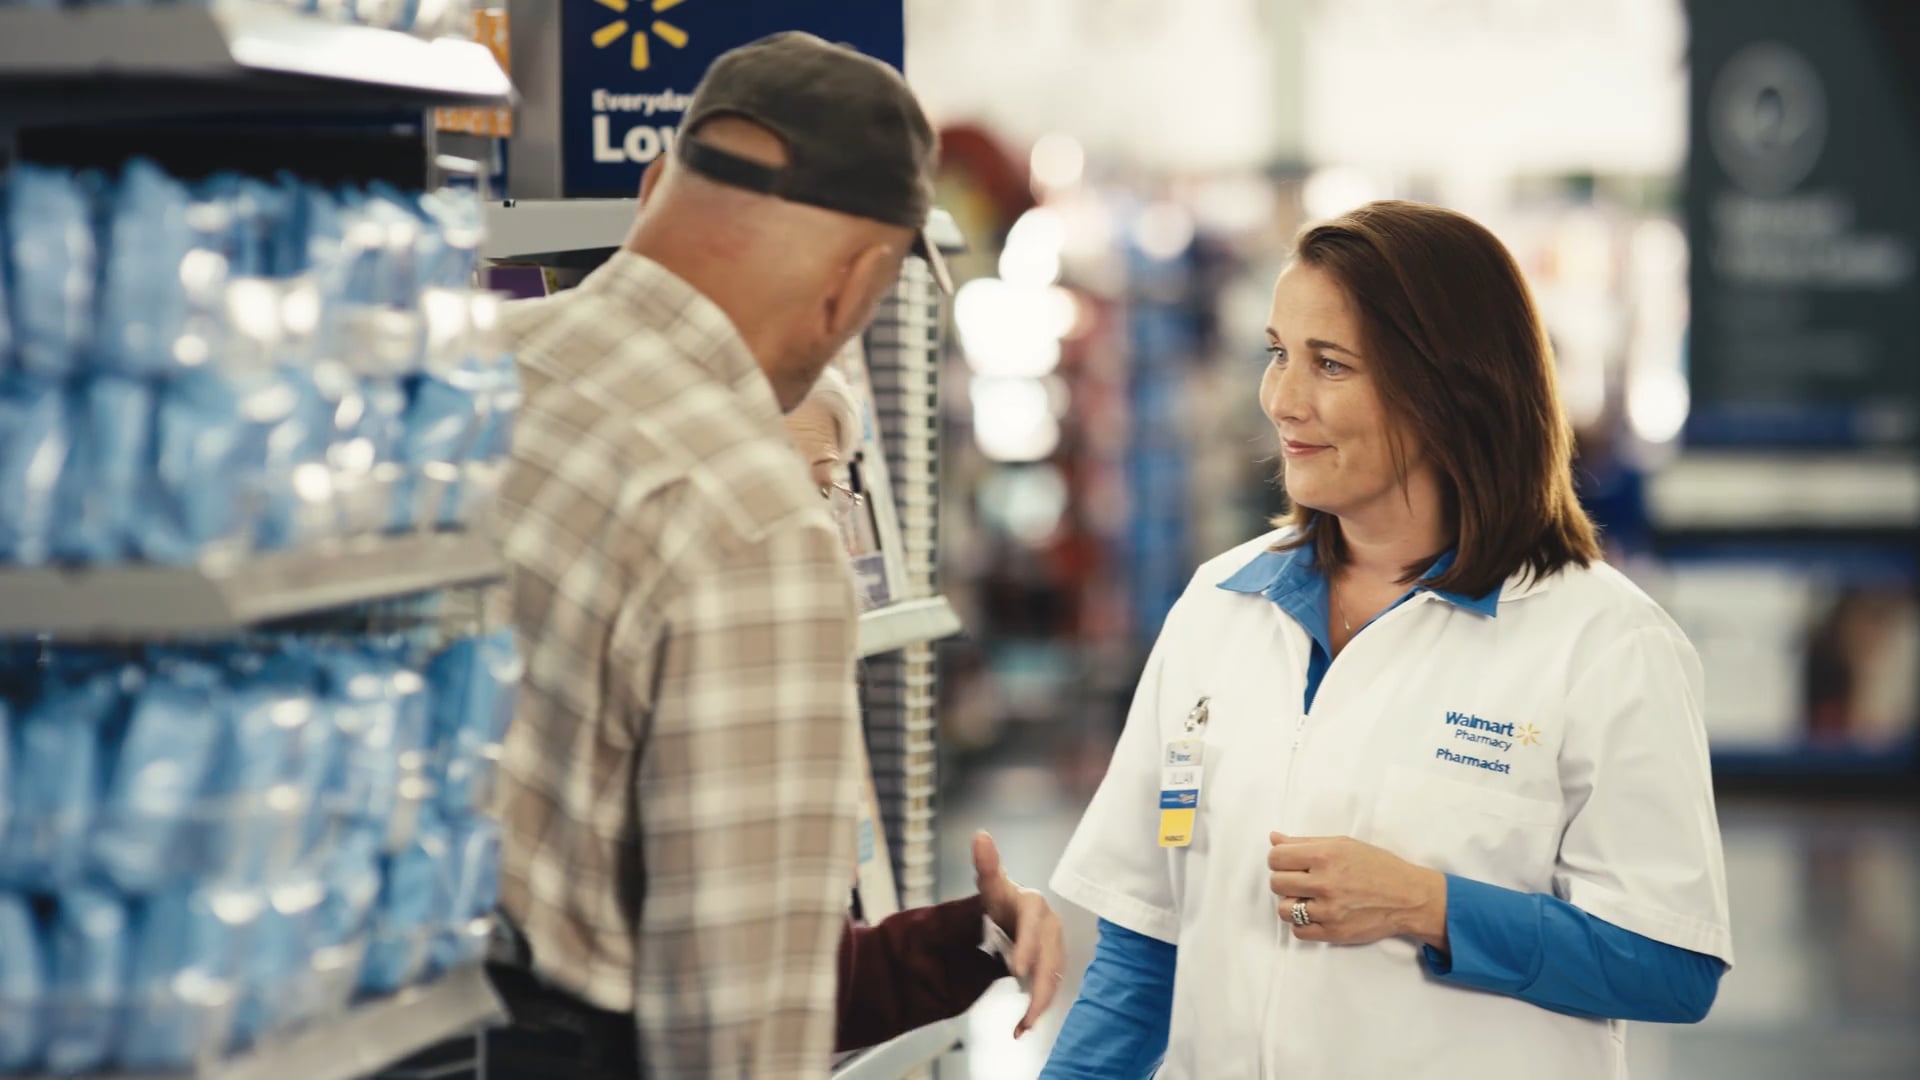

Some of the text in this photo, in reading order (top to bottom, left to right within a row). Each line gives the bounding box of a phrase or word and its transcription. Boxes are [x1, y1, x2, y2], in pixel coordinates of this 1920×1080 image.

[1446, 711, 1514, 737] Walmart
[1455, 729, 1512, 752] Pharmacy
[1436, 748, 1510, 774] Pharmacist
